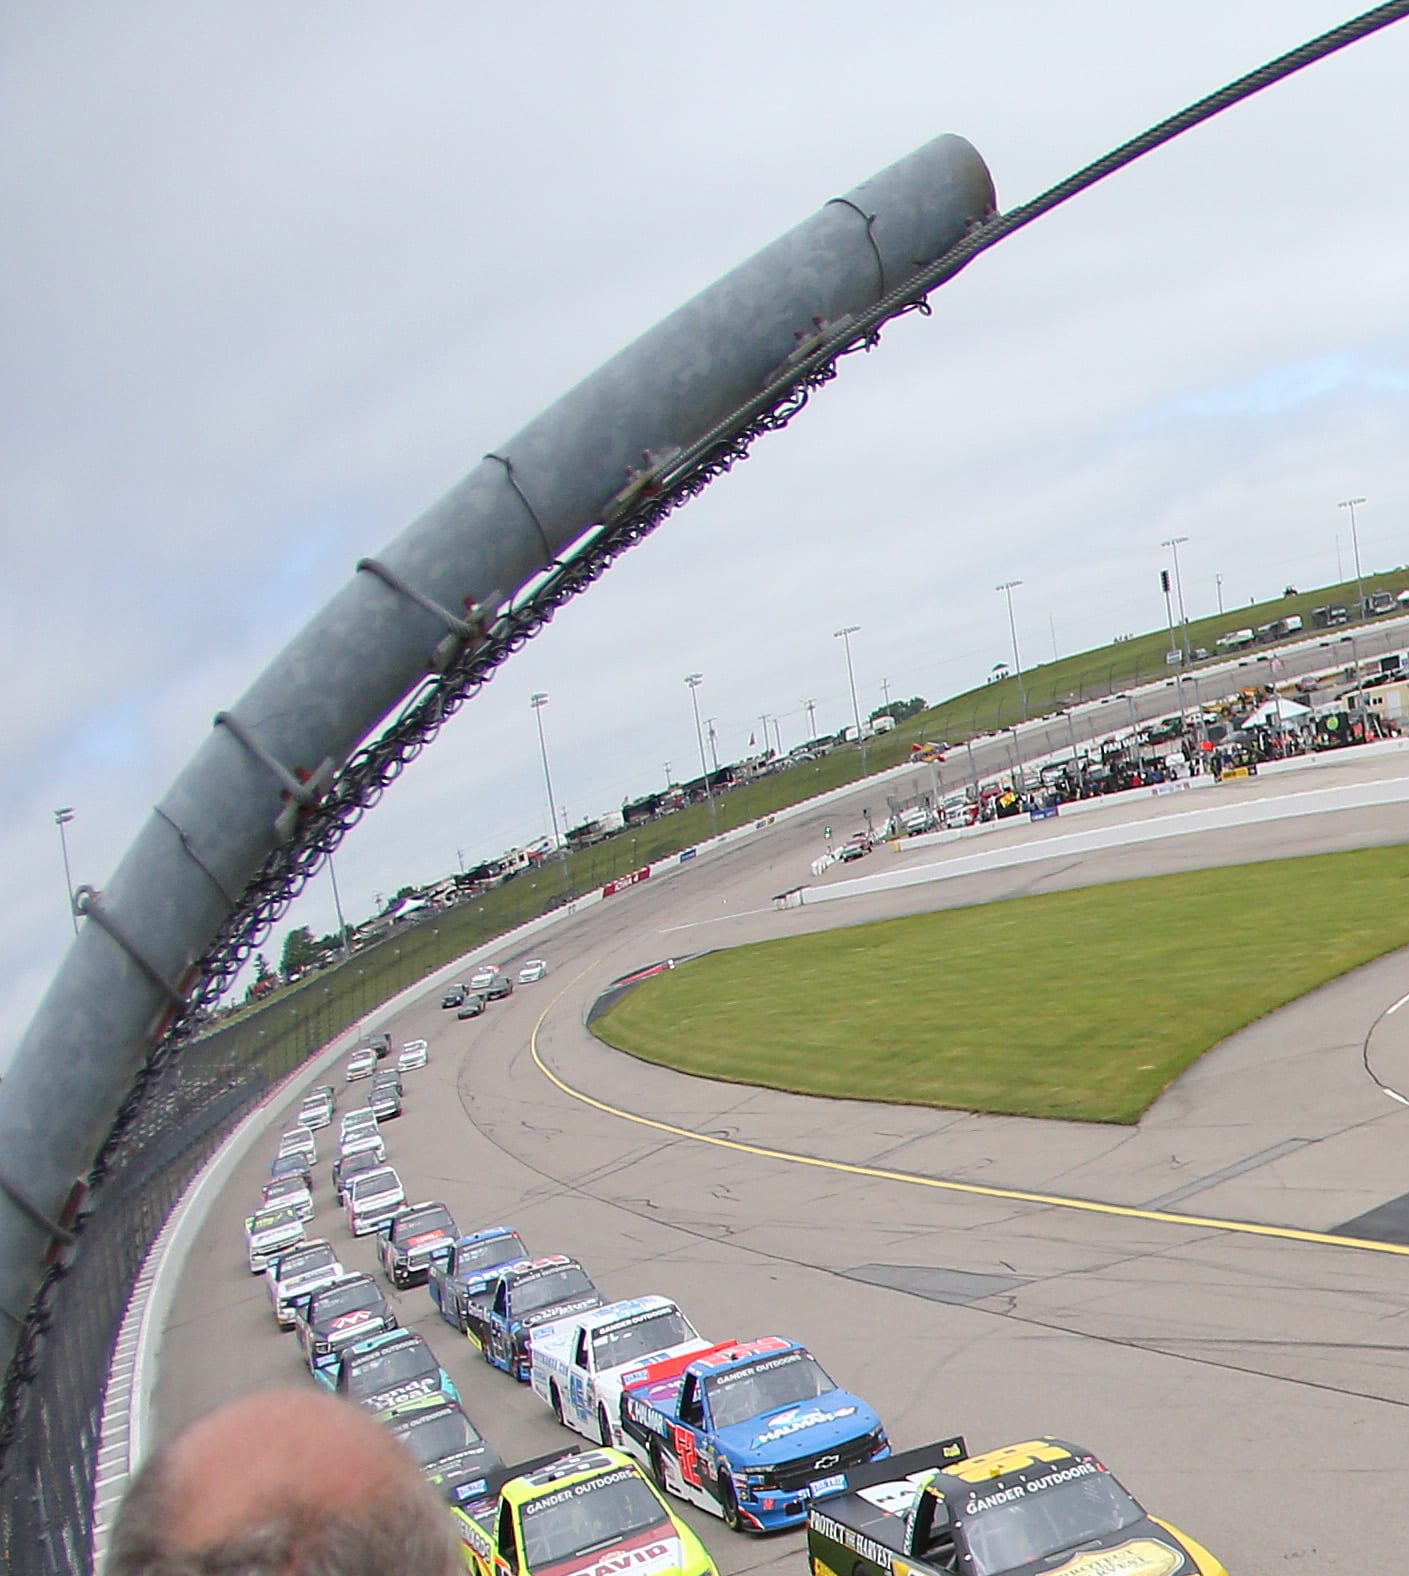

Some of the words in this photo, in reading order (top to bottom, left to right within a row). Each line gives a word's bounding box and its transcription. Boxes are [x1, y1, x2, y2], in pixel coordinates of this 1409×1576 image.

[1104, 739, 1122, 754] FAN
[717, 1367, 756, 1386] GANDER
[526, 1490, 573, 1515] GANDER
[575, 1469, 634, 1497] OUTDOORS
[966, 1486, 1025, 1515] GANDER
[1029, 1462, 1096, 1493] OUTDOORS
[809, 1510, 846, 1545] PROTECT
[856, 1533, 893, 1570] HARVEST
